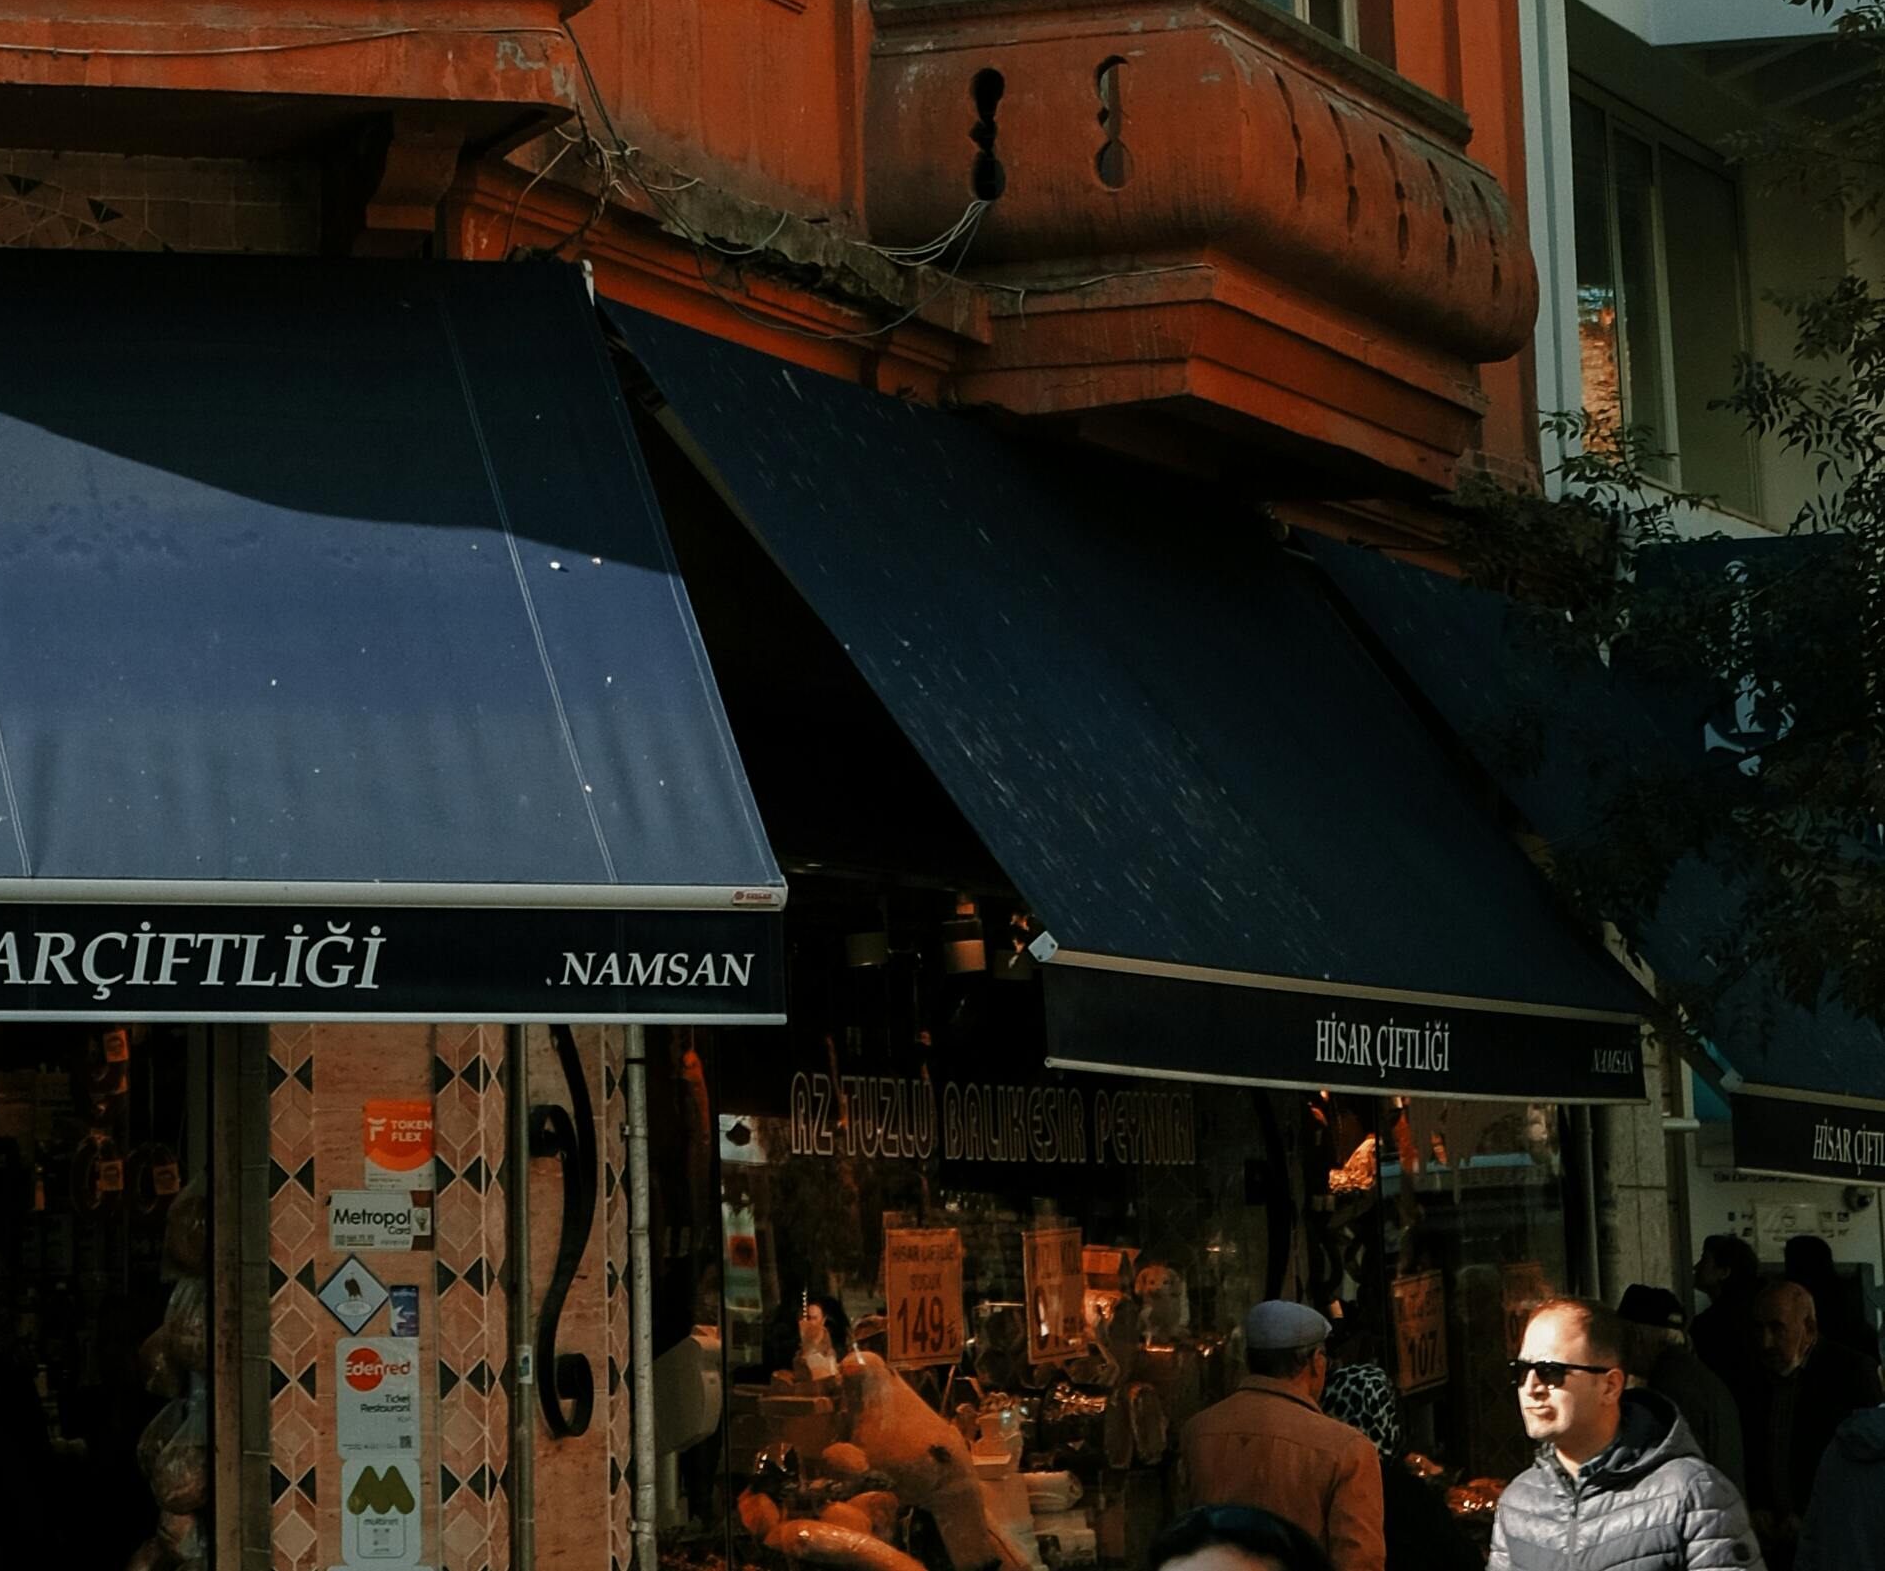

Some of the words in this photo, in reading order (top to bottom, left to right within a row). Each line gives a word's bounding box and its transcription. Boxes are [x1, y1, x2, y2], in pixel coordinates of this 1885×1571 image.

[559, 952, 755, 987] NAMSAN
[1315, 1011, 1373, 1067] HİSAR
[1376, 1017, 1451, 1078] ÇİFTLİĞİ
[391, 1119, 433, 1130] TOKEN
[840, 1075, 933, 1160] TUZLU
[391, 1132, 422, 1142] FLEX
[1813, 1118, 1852, 1163] HİSAR
[333, 1208, 412, 1228] Metropol
[345, 1361, 412, 1376] Edenred
